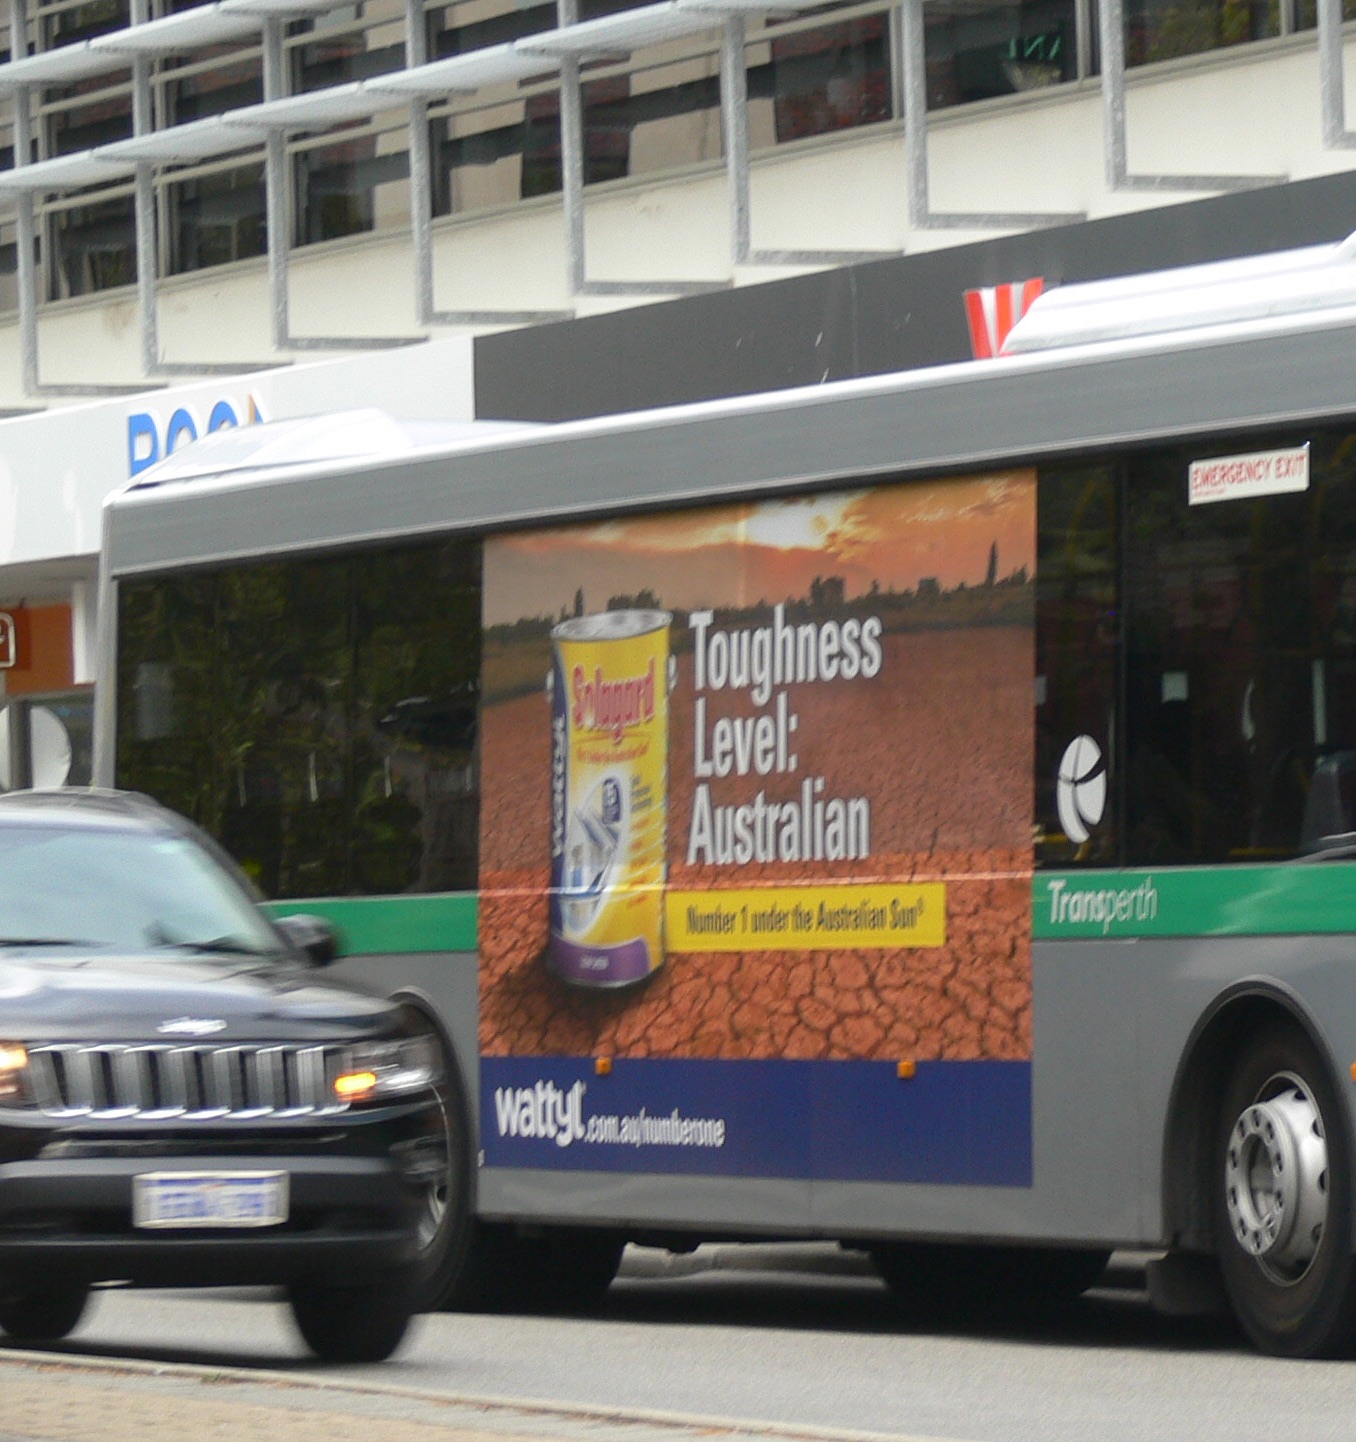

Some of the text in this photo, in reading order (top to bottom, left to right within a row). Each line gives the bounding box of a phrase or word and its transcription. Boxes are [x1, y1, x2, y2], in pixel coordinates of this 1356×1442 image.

[1192, 453, 1307, 489] EMERGENCY EXIT
[689, 603, 883, 706] Toughness
[694, 691, 798, 777] Level:
[685, 776, 870, 866] Australian
[686, 905, 737, 934] Number
[740, 904, 748, 931] 1
[752, 902, 790, 931] under
[792, 902, 814, 930] the
[816, 900, 887, 931] Australian
[1047, 875, 1158, 934] Transperth
